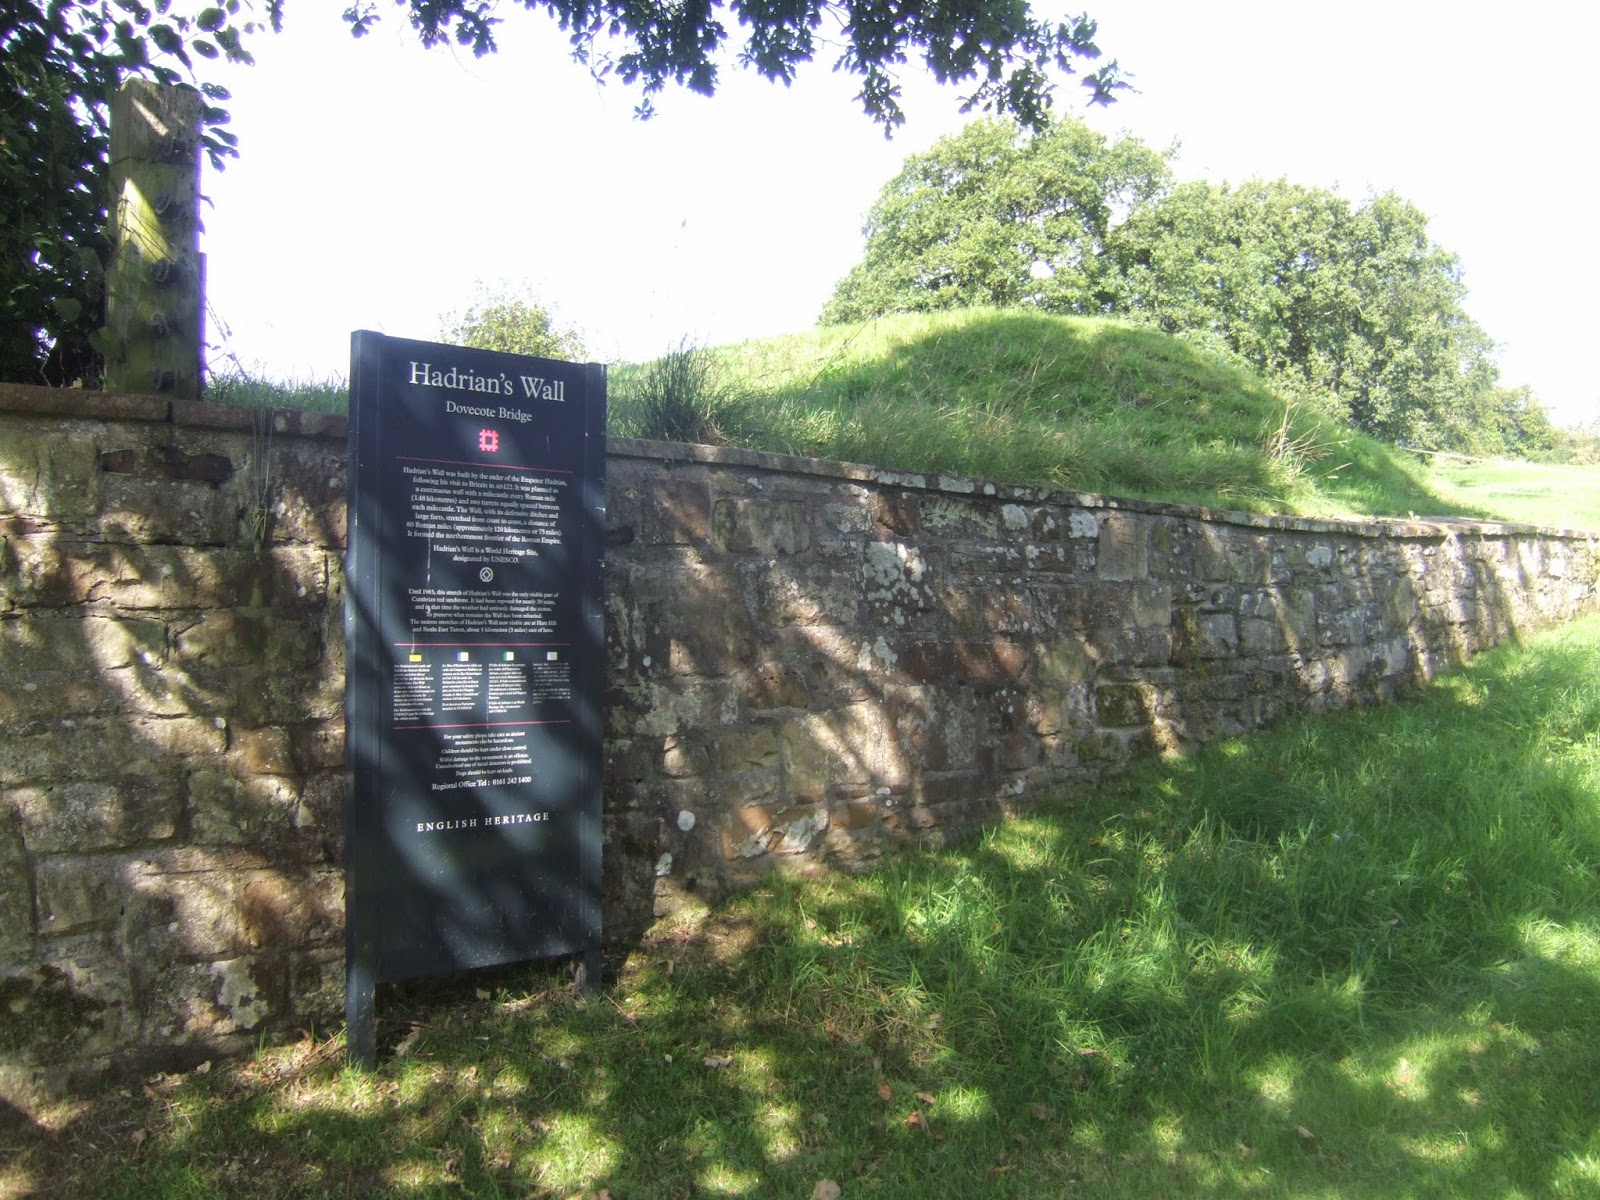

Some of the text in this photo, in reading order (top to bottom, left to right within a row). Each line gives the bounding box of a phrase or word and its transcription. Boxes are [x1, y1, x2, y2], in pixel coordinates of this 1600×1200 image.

[409, 361, 565, 402] Hadrian's Wall
[446, 401, 532, 424] Dovecote Bridge
[404, 467, 431, 475] Hadrian's
[521, 476, 543, 484] Emperor
[413, 476, 439, 485] following
[531, 486, 552, 494] planned
[420, 486, 451, 494] continuous
[453, 555, 482, 563] designated
[503, 548, 525, 556] Heritage
[432, 782, 457, 791] Regional
[459, 780, 476, 788] Office
[417, 812, 549, 832] ENGLISH HERITAGE
